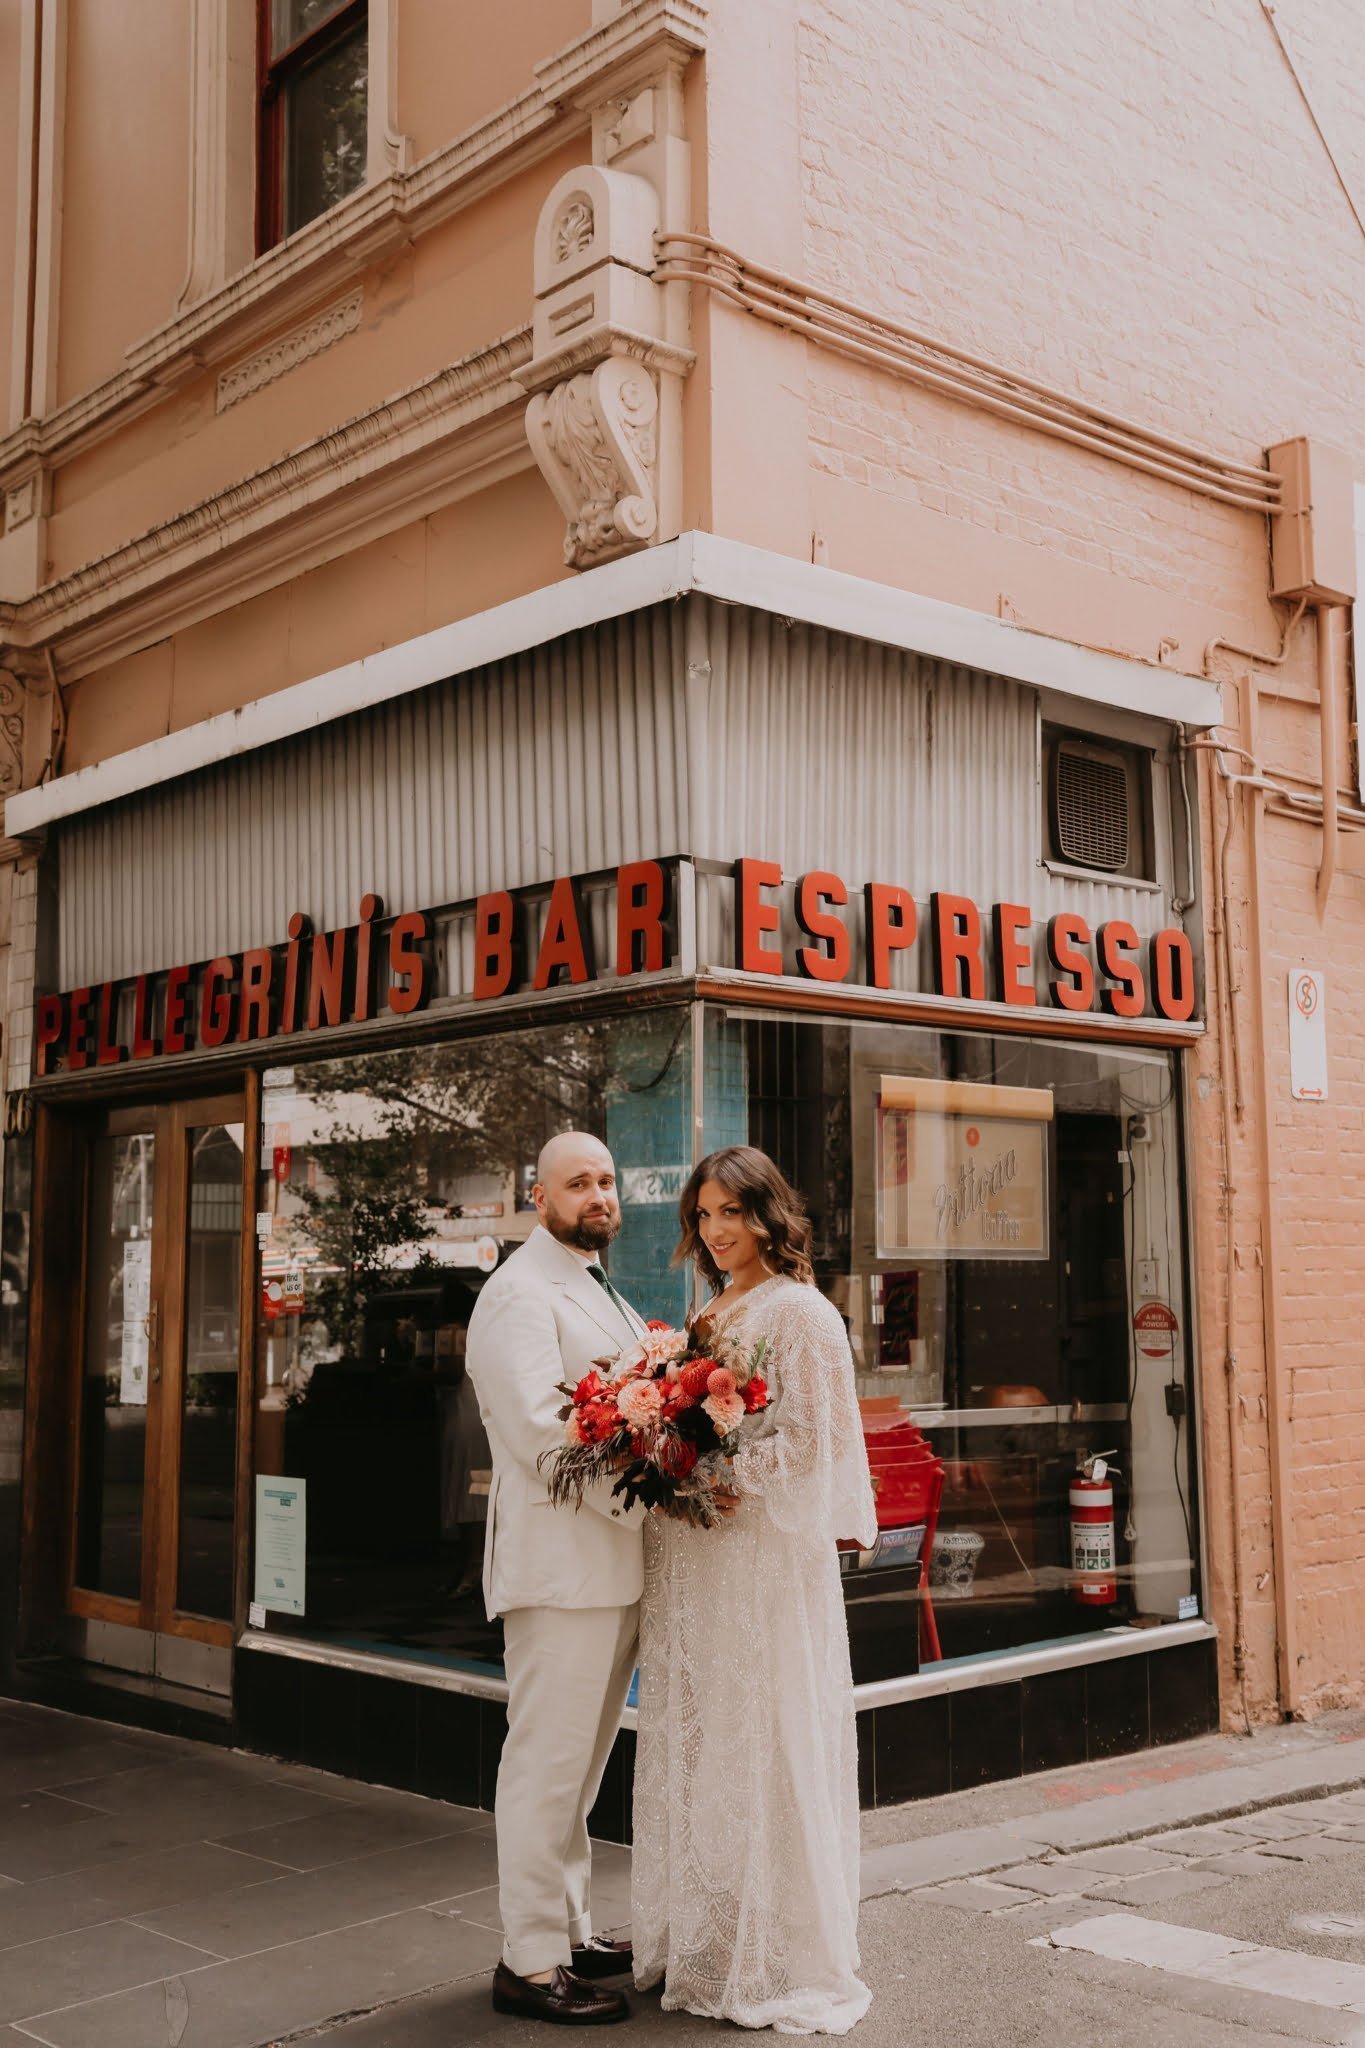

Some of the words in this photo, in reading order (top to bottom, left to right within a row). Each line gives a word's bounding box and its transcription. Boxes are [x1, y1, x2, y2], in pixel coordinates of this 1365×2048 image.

[472, 859, 669, 1001] BAR
[734, 856, 1196, 1022] ESPRESSO
[286, 1274, 298, 1282] find
